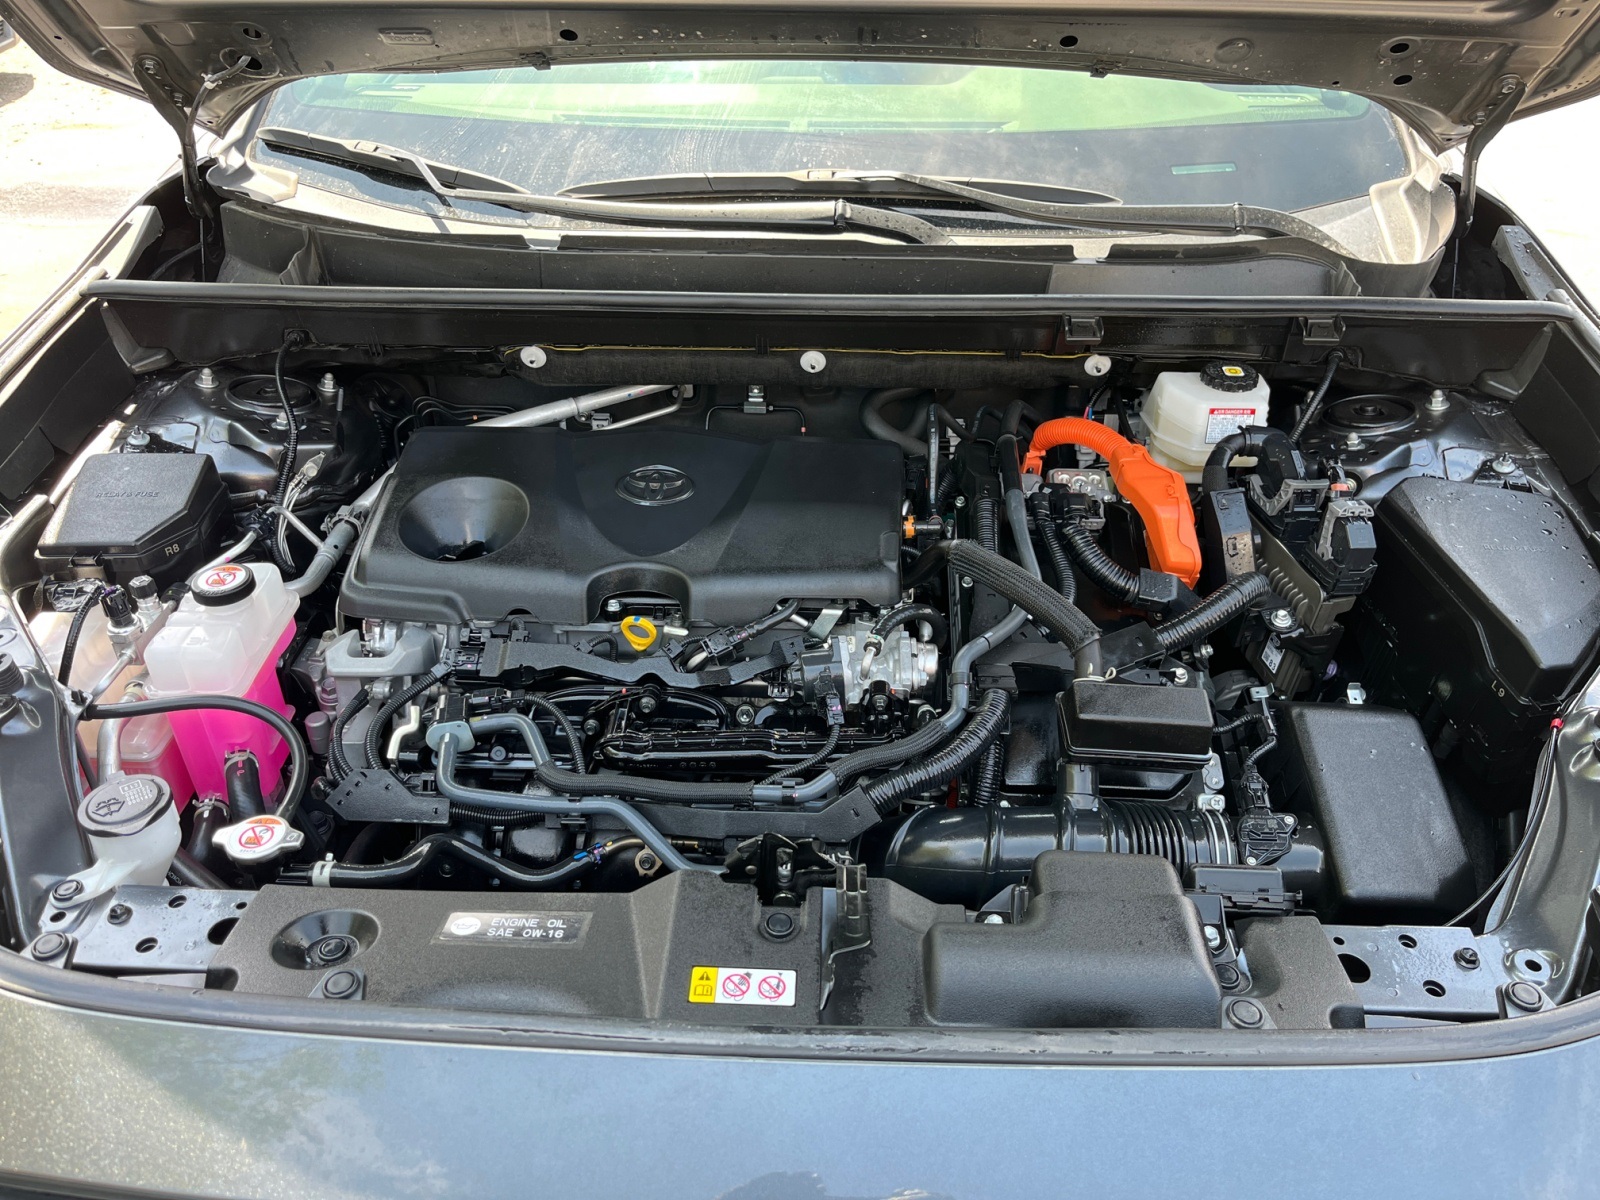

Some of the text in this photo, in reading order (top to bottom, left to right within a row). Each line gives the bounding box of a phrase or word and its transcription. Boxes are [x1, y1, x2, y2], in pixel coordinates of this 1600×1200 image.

[164, 543, 180, 556] R8
[1491, 679, 1505, 697] L9
[491, 917, 567, 928] ENGINE OIL
[487, 928, 564, 938] SAE 0W-16
